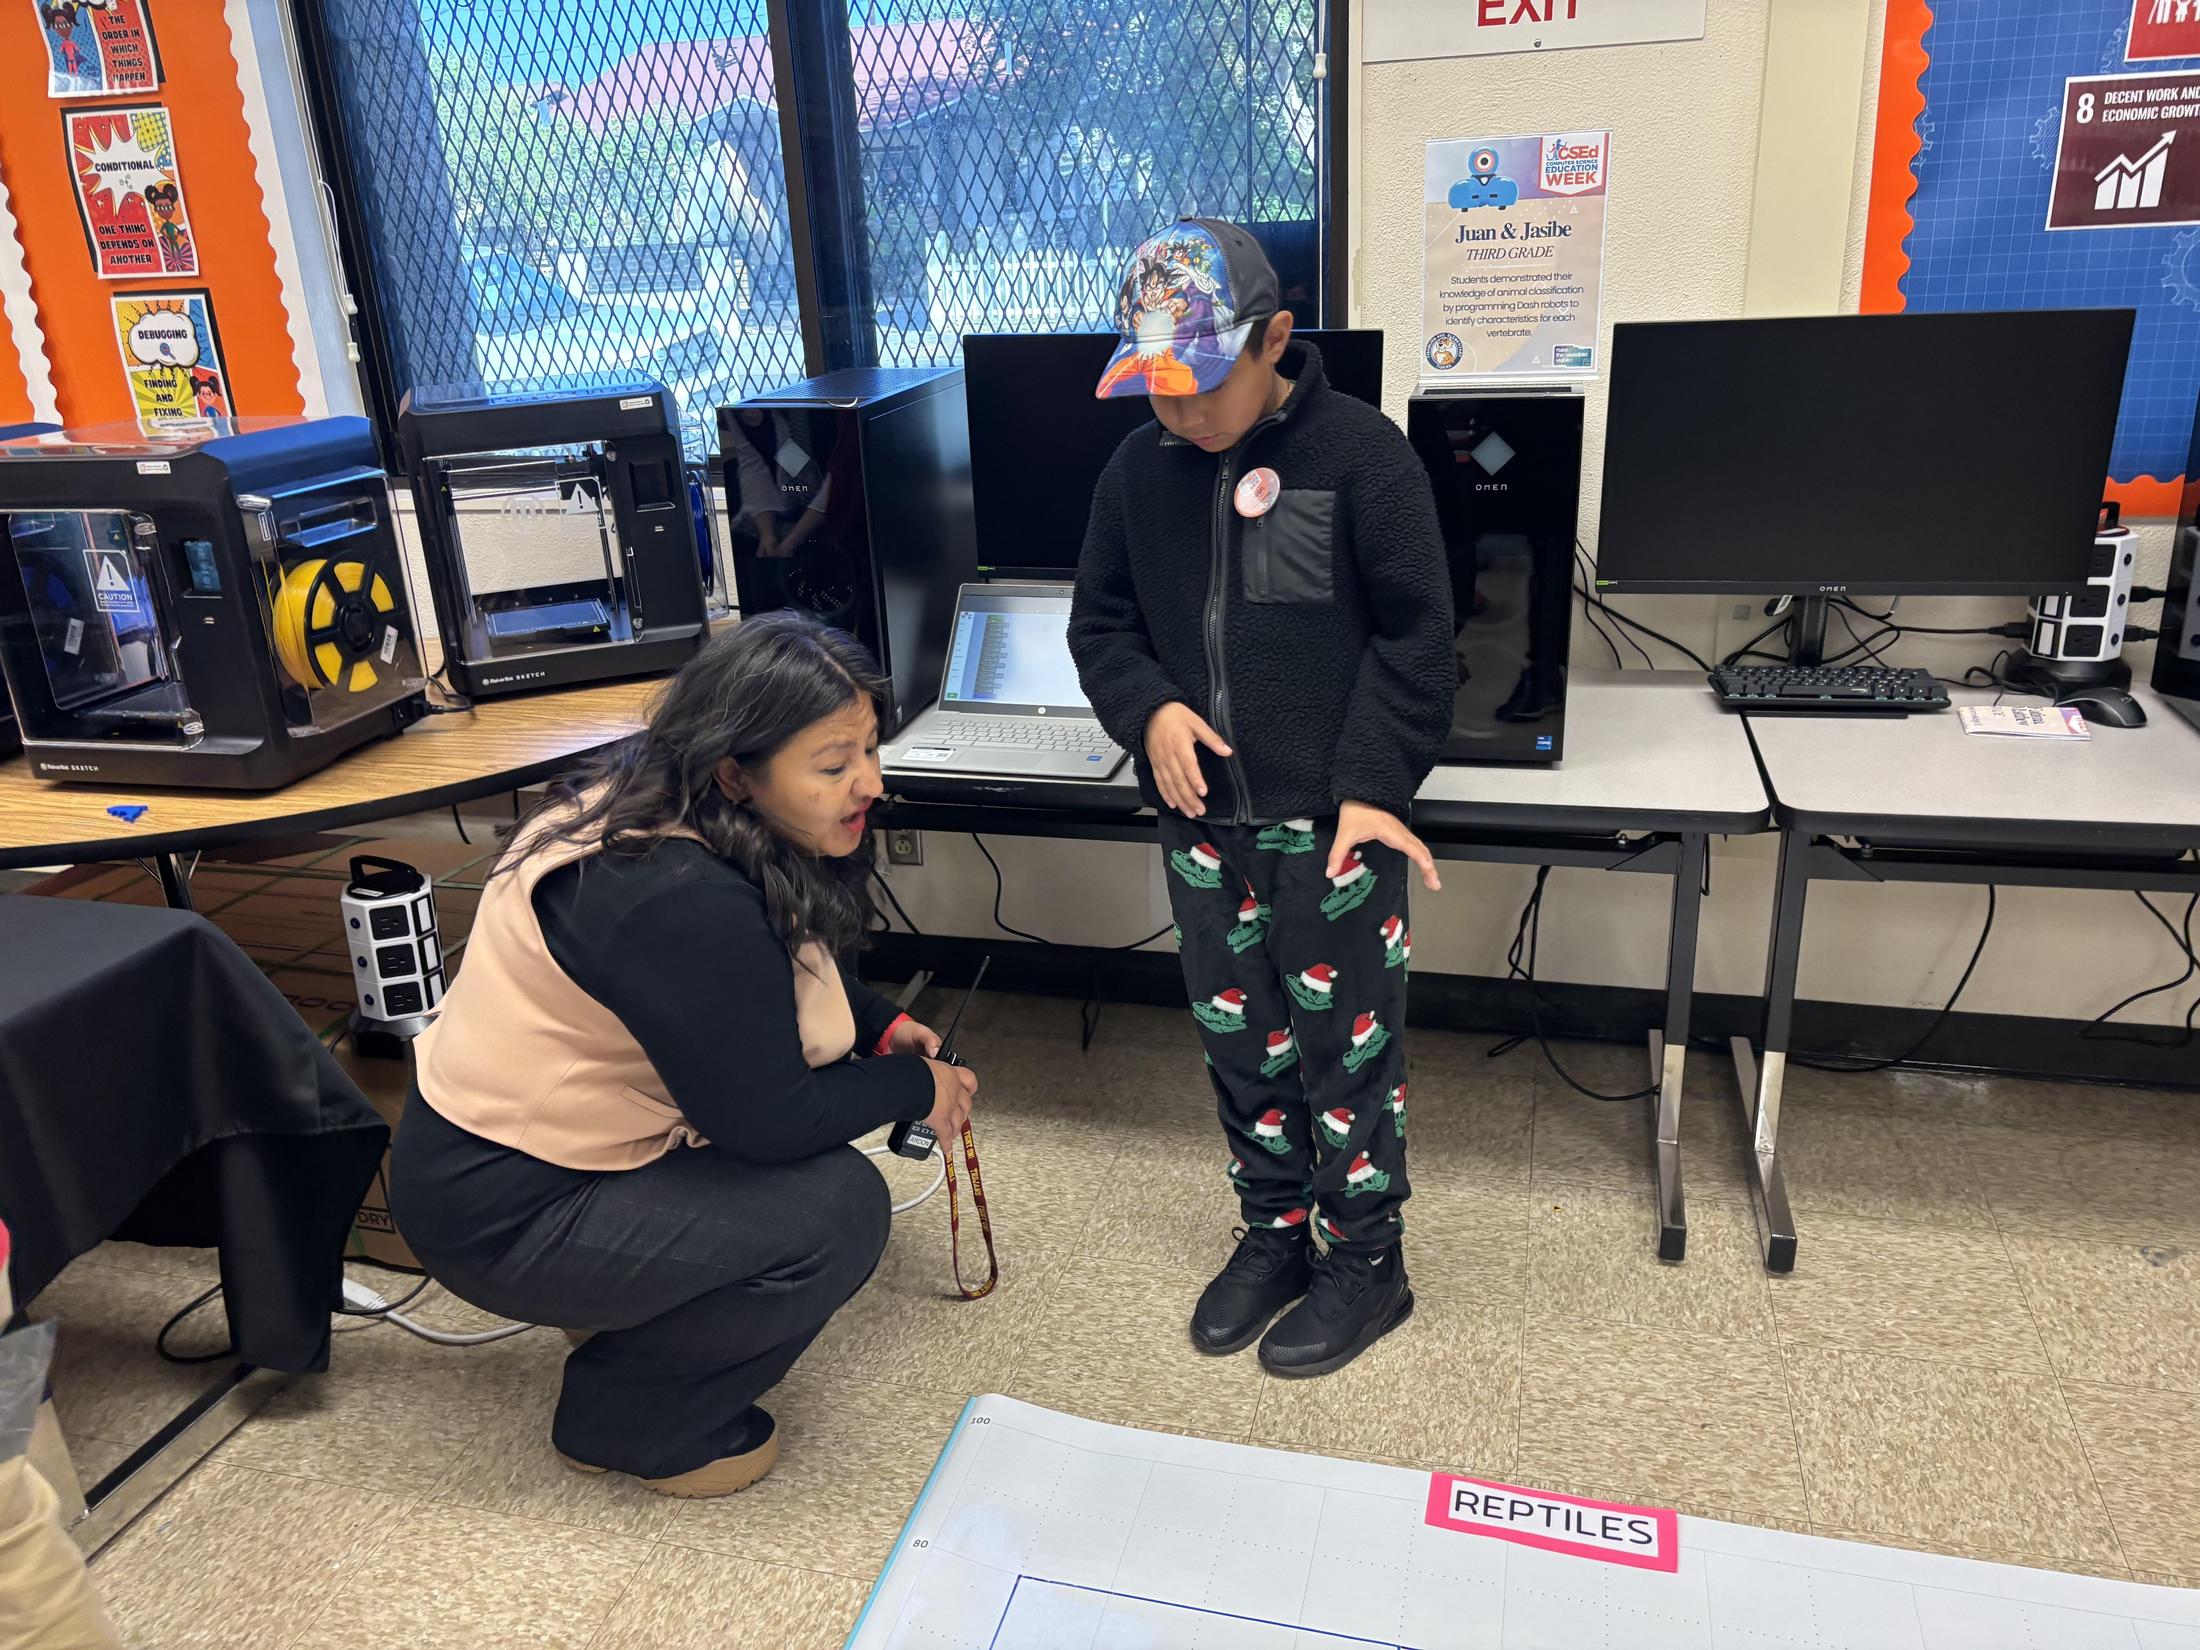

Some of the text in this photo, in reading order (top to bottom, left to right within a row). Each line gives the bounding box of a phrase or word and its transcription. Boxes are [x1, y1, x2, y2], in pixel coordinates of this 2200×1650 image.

[108, 15, 126, 24] THE
[102, 28, 140, 40] ORDER IN
[111, 44, 139, 54] WHICH
[112, 58, 143, 68] THINGS
[113, 72, 145, 82] HAPPEN
[2104, 90, 2144, 105] DECENT
[2146, 87, 2180, 102] WORK
[2076, 93, 2095, 124] 8
[2102, 104, 2200, 122] ECONOMIC GROWT
[1558, 145, 1599, 160] CSEd
[95, 160, 155, 172] CONDITIONAL
[1545, 164, 1598, 173] EDUCATION
[1545, 171, 1597, 186] WEEK
[99, 224, 146, 235] ONE THING
[1455, 220, 1572, 244] Juan & Jasibe
[100, 239, 155, 250] DEPENDS ON
[1467, 245, 1555, 261] THIRD GRADE
[111, 254, 152, 264] ANOTHER
[1451, 271, 1573, 285] Students demonstrated their
[1440, 284, 1584, 299] knowledge of animal classification
[1443, 299, 1579, 314] by programming Dash robots to
[1446, 312, 1576, 327] identify characteristics for each
[138, 329, 188, 340] DEBUGGING
[144, 379, 178, 388] FINDING
[156, 394, 174, 402] AND
[154, 407, 183, 417] FIXING
[1475, 483, 1508, 491] OMEN
[98, 593, 133, 601] CAUTION
[516, 671, 546, 681] SKETCH
[71, 764, 99, 772] SKETCH
[970, 1167, 982, 1197] TROJANS
[358, 1211, 389, 1227] DRY
[970, 1417, 991, 1425] 100
[1455, 1489, 1653, 1545] REPTILES
[912, 1539, 929, 1549] 80
